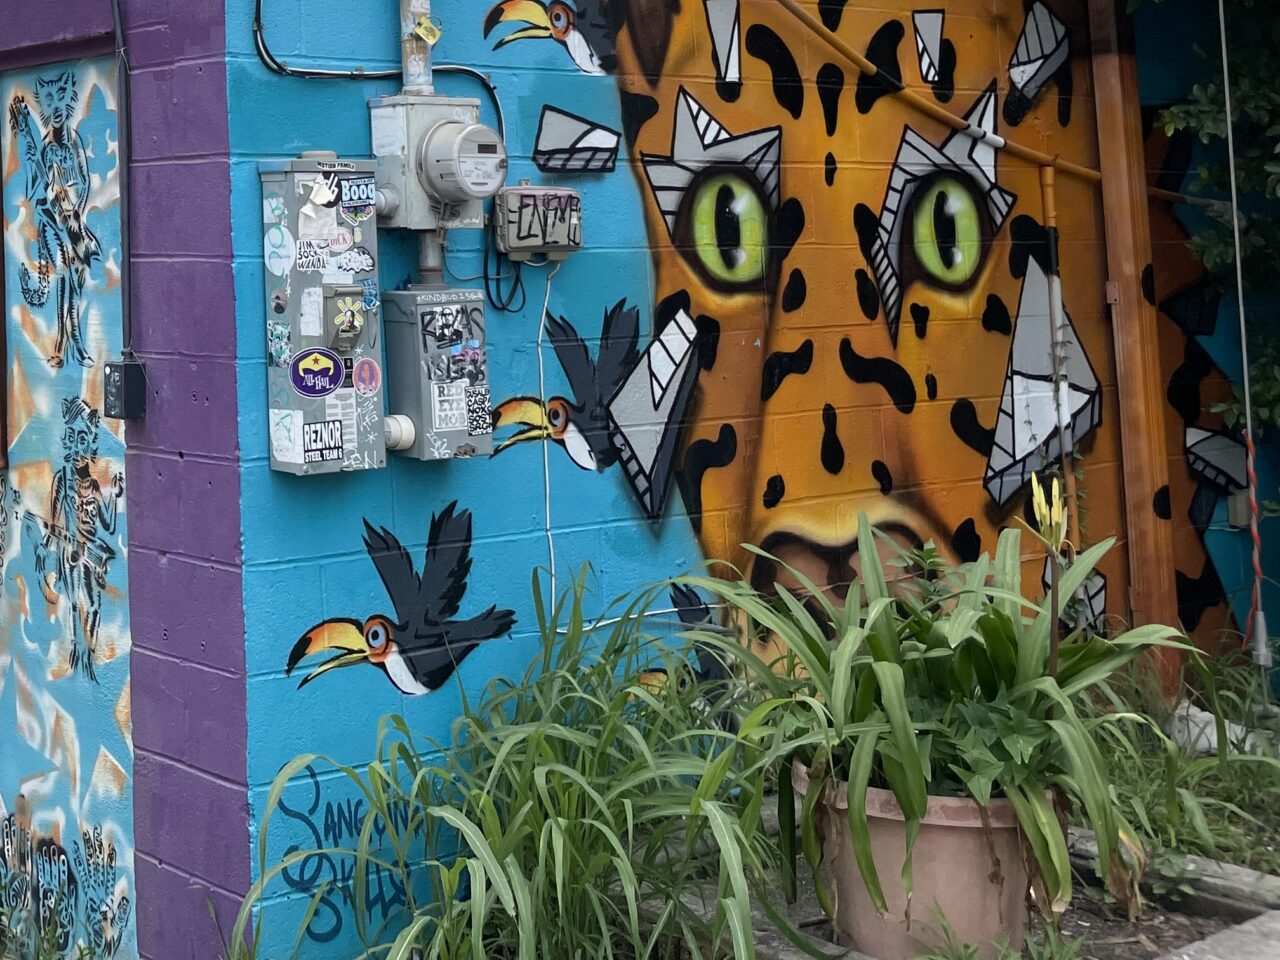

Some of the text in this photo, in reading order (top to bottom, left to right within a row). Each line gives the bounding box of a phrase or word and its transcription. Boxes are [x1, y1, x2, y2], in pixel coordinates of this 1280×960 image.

[340, 180, 376, 205] Boog
[299, 240, 315, 251] JIM
[437, 384, 464, 398] RED
[438, 399, 465, 412] EYE
[438, 412, 466, 427] MOB
[304, 420, 343, 451] REZNOR
[305, 450, 322, 463] STEEL
[323, 448, 338, 460] TEAM
